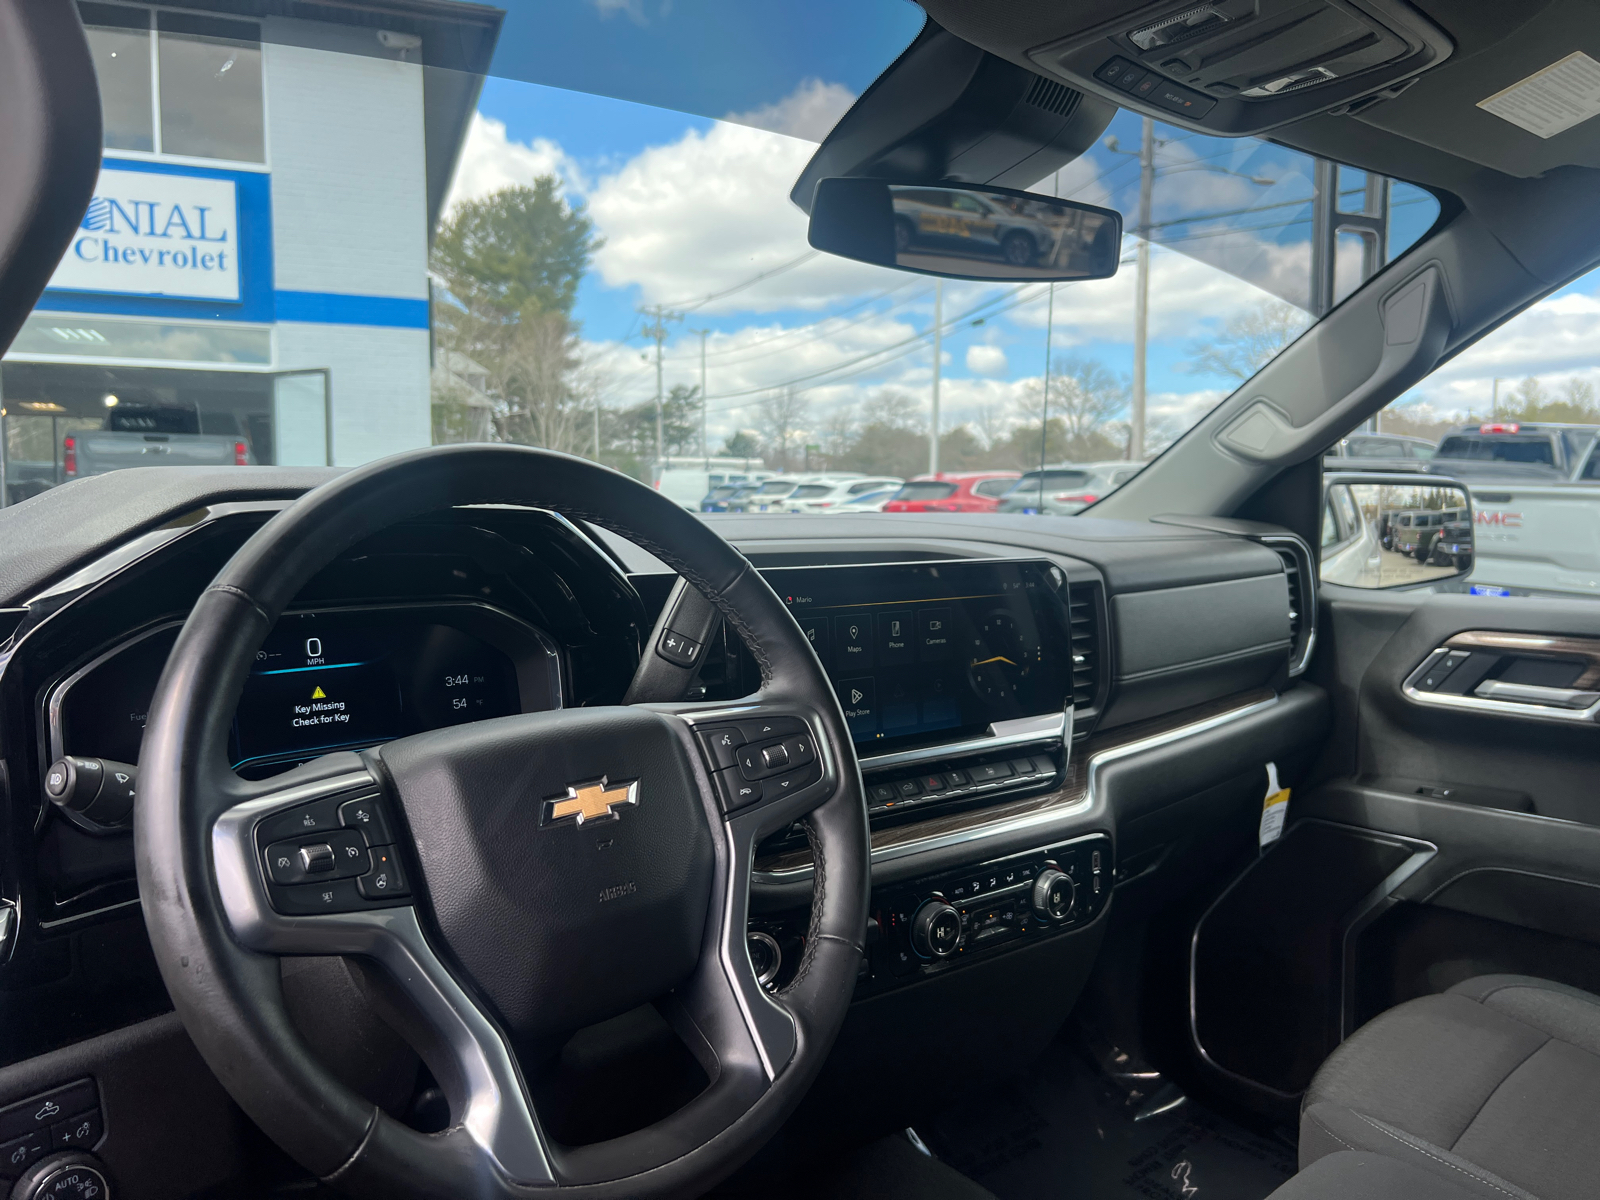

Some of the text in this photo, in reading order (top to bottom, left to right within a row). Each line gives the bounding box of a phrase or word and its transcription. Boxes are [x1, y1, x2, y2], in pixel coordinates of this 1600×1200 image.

[74, 236, 228, 271] Chevrolet
[1473, 510, 1523, 527] MC
[307, 637, 322, 657] 0
[926, 637, 947, 645] Cameras
[847, 645, 862, 653] Maps
[307, 658, 325, 666] MPH
[445, 674, 469, 687] 3:44
[295, 701, 345, 715] Key Missing
[453, 697, 468, 710] 54
[845, 708, 871, 718] Play Store
[292, 713, 350, 727] Check for Key
[322, 891, 333, 900] SET
[55, 1174, 79, 1191] AUTO
